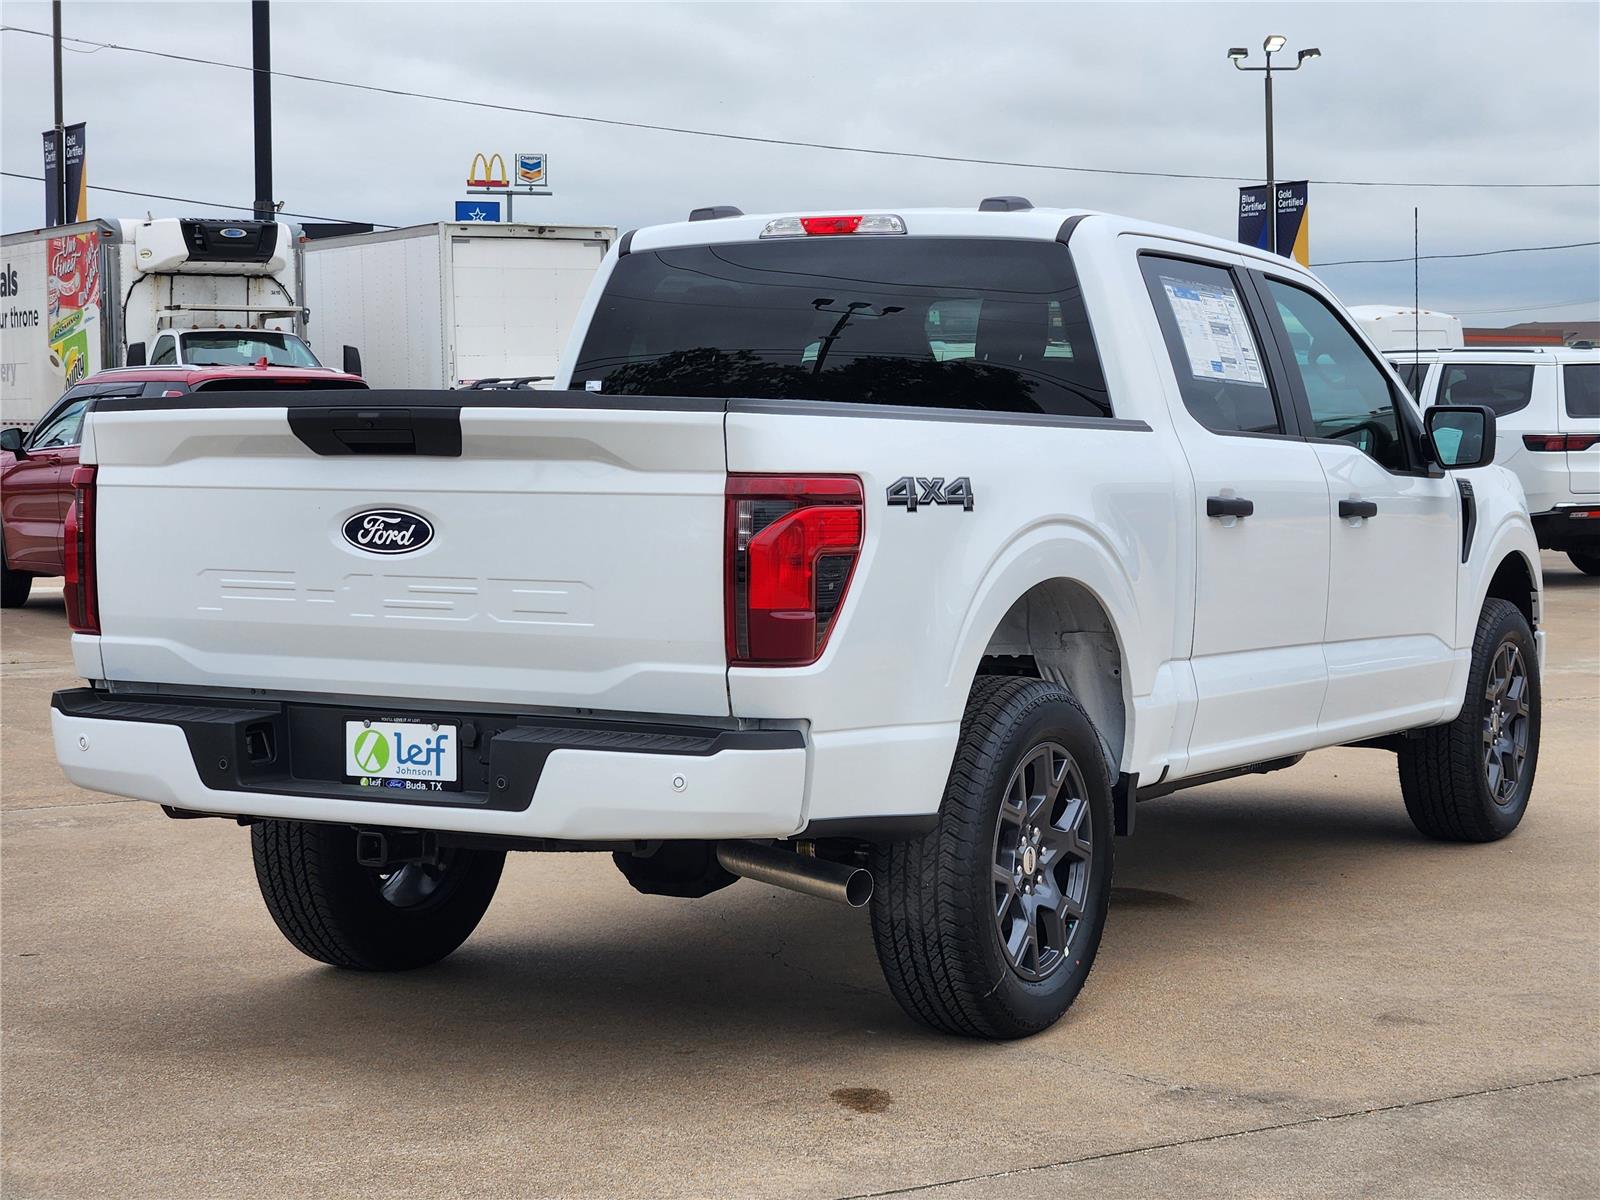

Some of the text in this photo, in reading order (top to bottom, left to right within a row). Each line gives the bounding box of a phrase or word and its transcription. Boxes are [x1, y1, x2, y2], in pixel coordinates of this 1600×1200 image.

[1241, 194, 1255, 203] Blue
[1278, 189, 1292, 199] Gold
[1241, 202, 1267, 212] Certified
[1278, 197, 1304, 208] Certified
[10, 306, 39, 329] throne
[357, 516, 416, 547] Ford
[395, 766, 433, 776] Johnson
[405, 780, 428, 791] Buda,
[430, 782, 443, 791] TX
